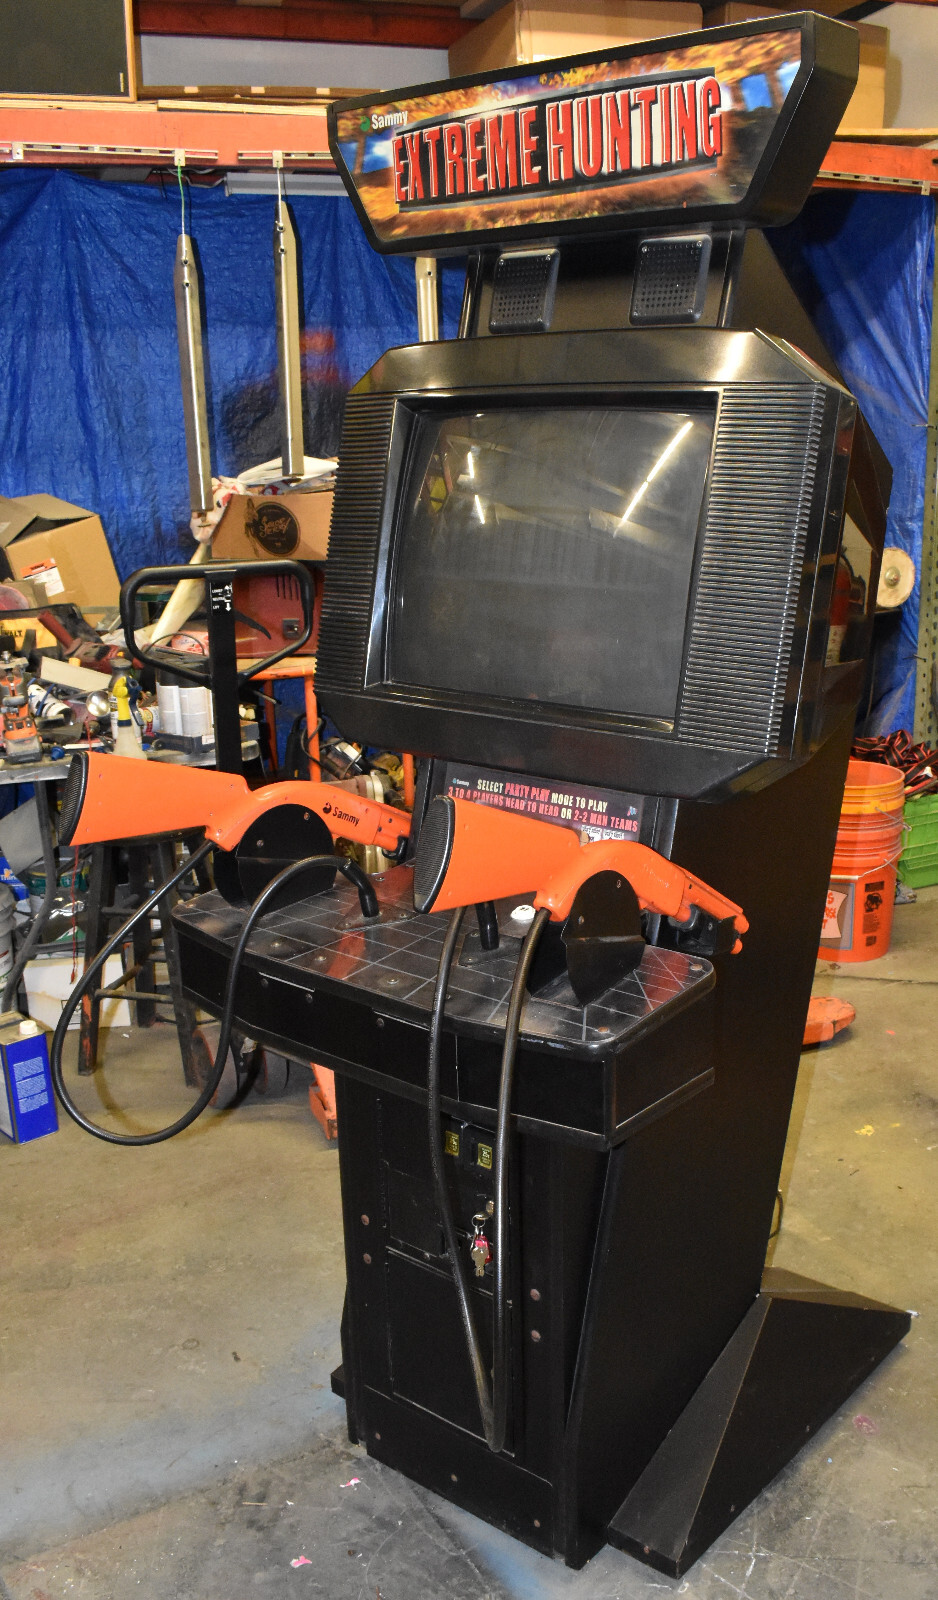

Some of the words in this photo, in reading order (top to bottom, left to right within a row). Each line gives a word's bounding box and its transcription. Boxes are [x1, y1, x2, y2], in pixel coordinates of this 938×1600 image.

[371, 110, 408, 130] Sammy
[392, 105, 541, 203] EXTREME
[546, 76, 723, 184] HUNTING
[448, 786, 453, 797] 3
[455, 787, 464, 799] TO
[465, 789, 471, 800] 4
[472, 791, 503, 807] PLAYERS
[505, 797, 525, 811] HEAD
[527, 801, 537, 813] TO
[539, 803, 559, 817] HEAD
[561, 807, 572, 820] OR
[573, 810, 588, 823] 2-2
[589, 812, 608, 827] MAN
[610, 816, 638, 833] TEAMS
[477, 779, 503, 793] SELECT
[504, 782, 529, 799] PARTY
[530, 787, 550, 802] PLAY
[551, 792, 574, 807] MODE
[575, 796, 586, 809] TO
[587, 799, 608, 813] PLAY
[333, 806, 360, 827] Sammy
